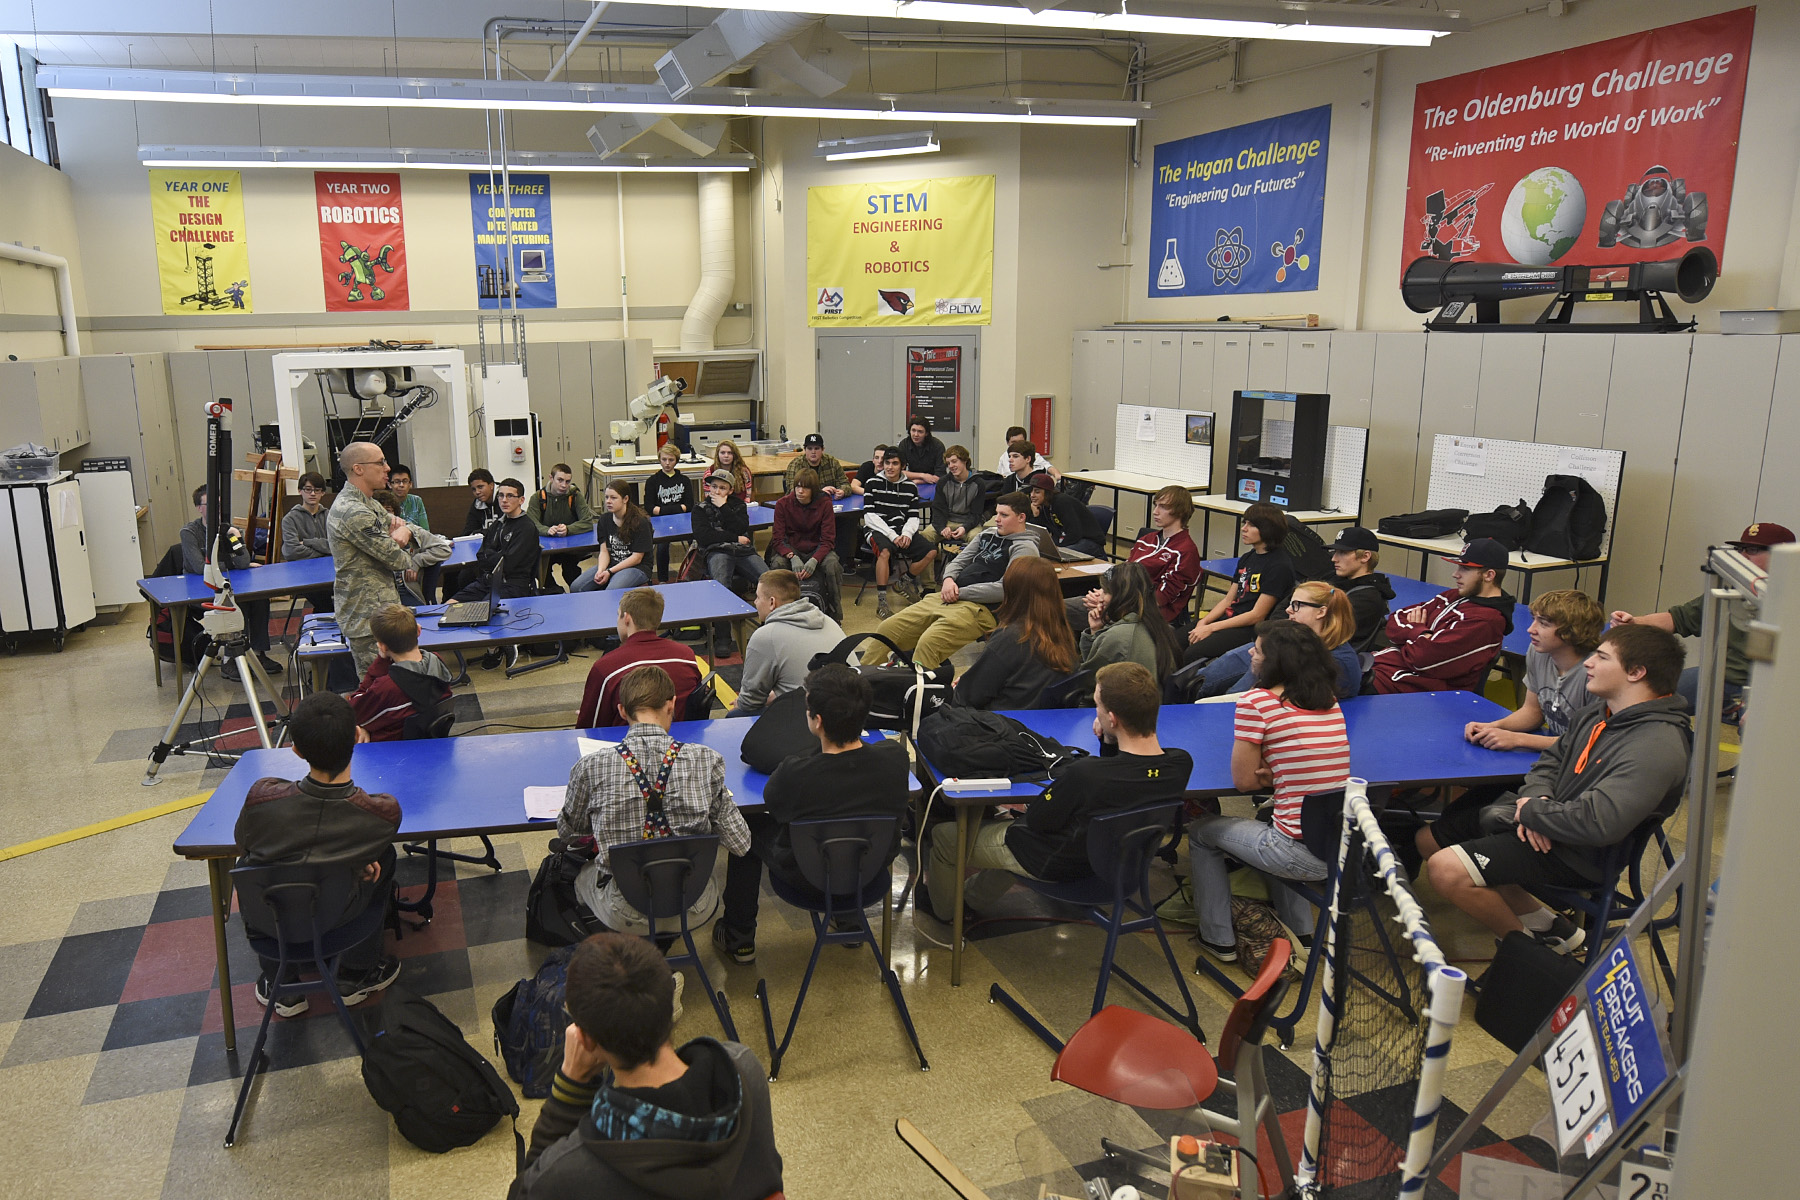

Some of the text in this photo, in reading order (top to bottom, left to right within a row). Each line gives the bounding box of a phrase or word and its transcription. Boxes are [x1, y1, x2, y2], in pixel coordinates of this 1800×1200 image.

[1424, 51, 1734, 130] The Oldenburg Challenge
[1424, 96, 1722, 162] “Re-inventing the World of Work”
[1159, 139, 1321, 184] The Hagan Challenge
[165, 181, 229, 193] YEAR ONE
[326, 182, 390, 194] YEAR TWO
[510, 184, 544, 194] THREE
[188, 196, 210, 208] THE
[867, 192, 928, 215] STEM
[1165, 186, 1228, 209] “Engineering
[1231, 183, 1252, 198] Our
[179, 212, 223, 226] DESIGN
[320, 206, 400, 224] ROBOTICS
[487, 221, 538, 232] INTERATED
[853, 218, 943, 234] ENGINEERING
[170, 230, 234, 243] CHALLENGE
[477, 234, 550, 244] MANUFCTURING
[890, 240, 900, 252] &
[864, 260, 930, 274] ROBOTICS
[949, 304, 982, 314] PLTW
[1607, 947, 1644, 1027] CIRCUIT
[1601, 1018, 1614, 1056] TEAM
[1608, 1052, 1620, 1083] 4513
[1603, 983, 1643, 1104] BREAKERS
[1553, 1029, 1596, 1131] 4513
